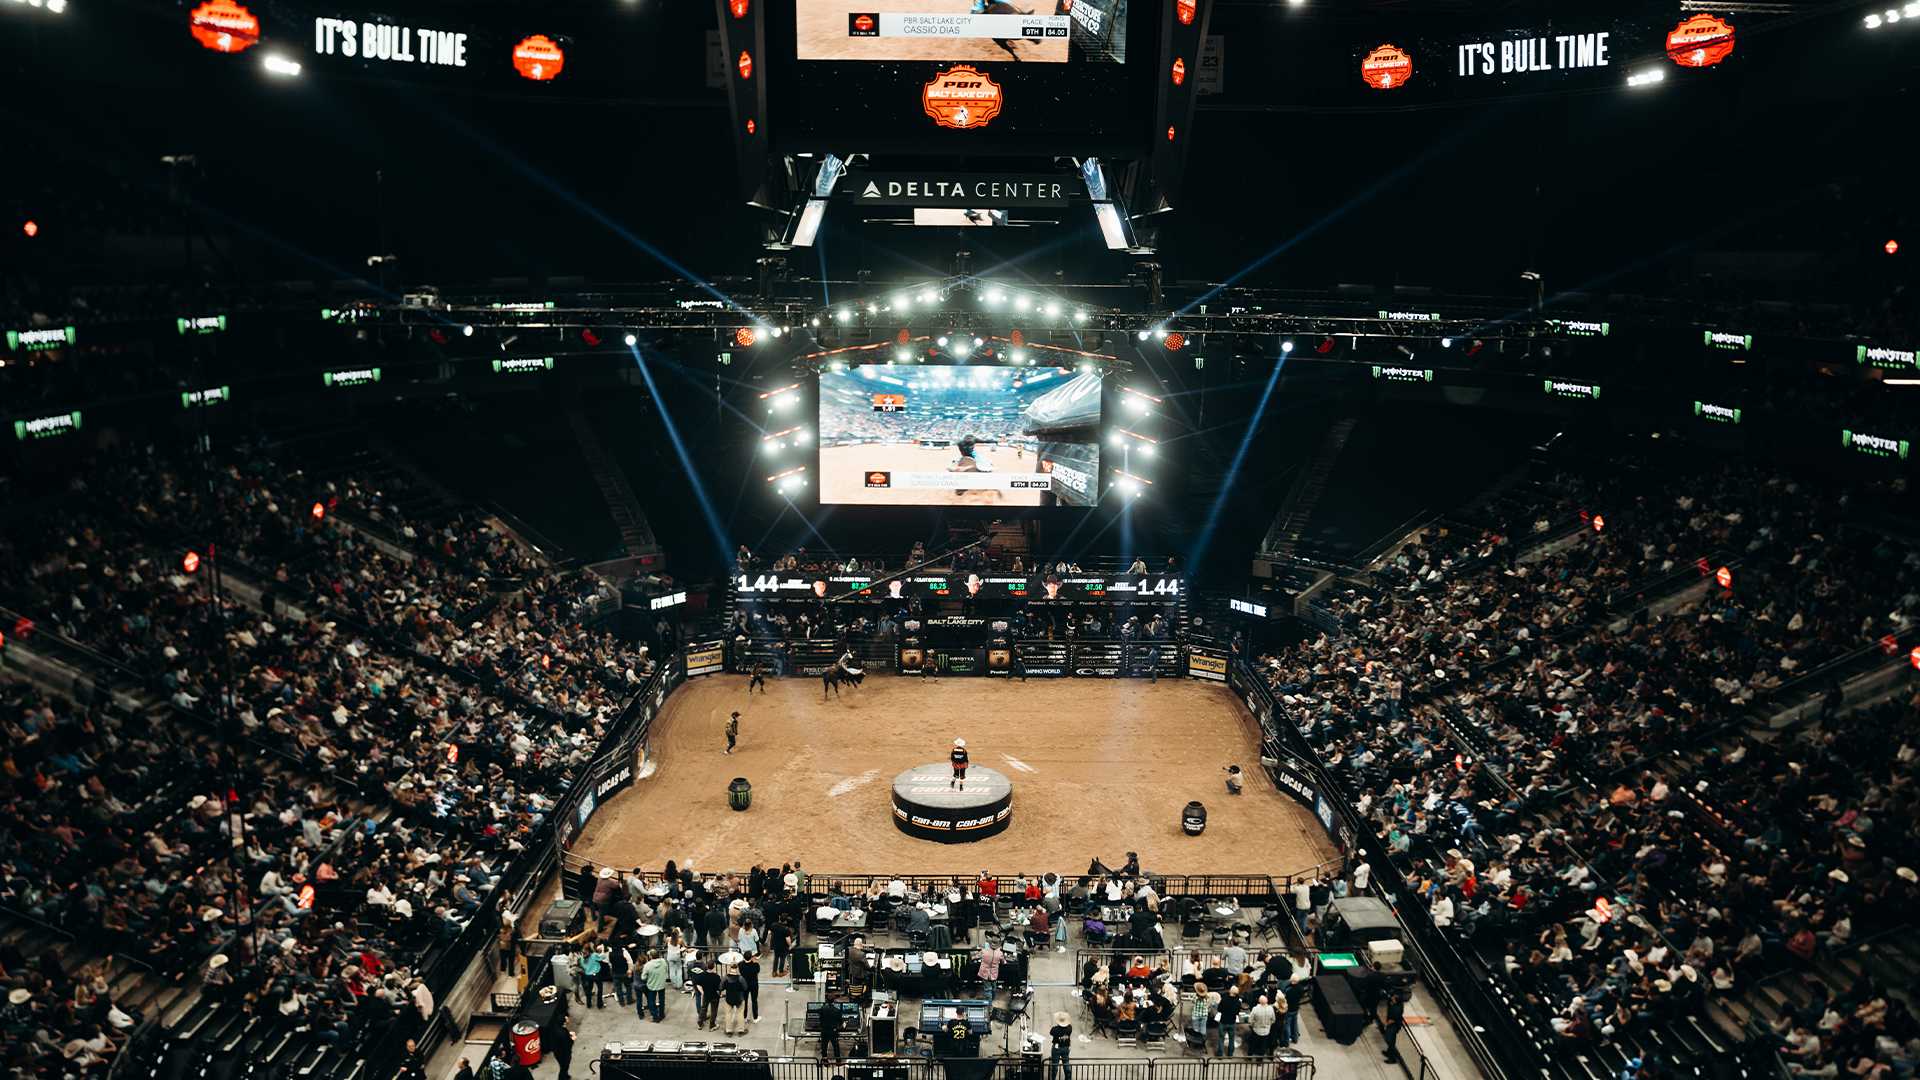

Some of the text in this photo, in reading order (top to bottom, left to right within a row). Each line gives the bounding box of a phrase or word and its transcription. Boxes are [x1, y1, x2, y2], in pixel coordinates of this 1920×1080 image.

[903, 16, 972, 25] PBR SALT LAKE CITY
[903, 25, 960, 34] CASSIO DIAS
[316, 17, 467, 68] IT'S BULL TIME
[1458, 32, 1609, 76] IT'S BULL TIME
[943, 81, 982, 89] PBR
[928, 90, 951, 98] SALT
[952, 90, 975, 98] LAKE
[888, 181, 1061, 199] DELTA CENTER
[737, 574, 780, 593] 1.44
[1137, 578, 1179, 596] 1.44
[688, 653, 720, 664] Wrangler
[1191, 656, 1224, 670] Wrangler
[597, 766, 631, 797] LUCAS OIL
[1279, 771, 1314, 802] LUCAS OIL
[955, 815, 995, 829] can-am
[953, 1029, 965, 1039] 23
